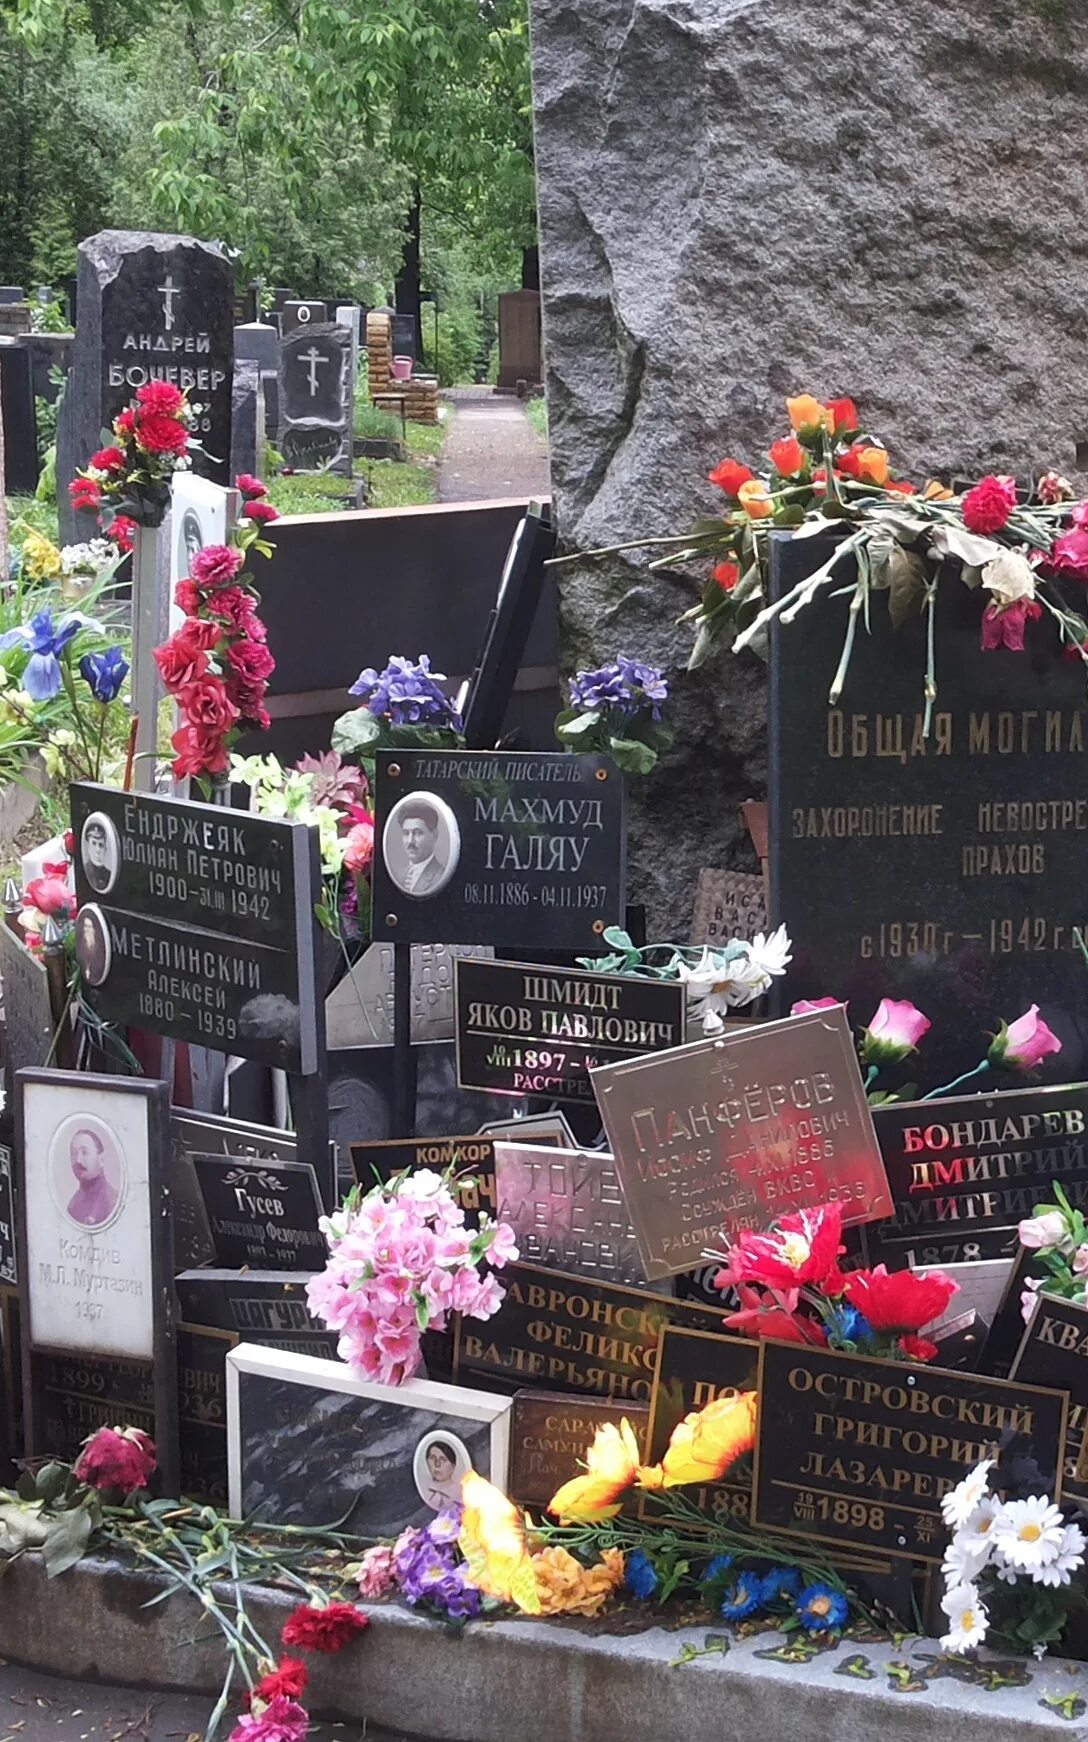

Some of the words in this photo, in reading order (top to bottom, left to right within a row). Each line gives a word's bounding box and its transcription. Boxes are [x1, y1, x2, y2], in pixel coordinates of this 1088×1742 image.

[122, 332, 211, 354] АНДРЕЙ
[108, 363, 226, 391] БОЧЕВЕР
[826, 710, 953, 764] ОБЩАЯ
[415, 757, 499, 780] ТАТАРСКИЙ
[504, 762, 583, 783] ПИСАТЕЛЬ
[123, 803, 247, 857] ЕНДРЖЕЯК
[473, 796, 604, 830] МАХМУД
[792, 804, 943, 838] ЗАХОРОНЕНИЕ
[122, 835, 179, 872] ЮЛИАН
[187, 850, 281, 895] ПЕТРОВИЧ
[483, 833, 591, 873] ГАЛЯУ
[962, 845, 1046, 877] ПРАХОВ
[149, 871, 188, 901] 1900
[231, 891, 271, 922] 1942
[464, 881, 530, 906] 08.11.1886
[541, 885, 607, 909] 04.11.1937
[111, 924, 262, 990] МЕТЛИНСКИЙ
[147, 968, 226, 1010] АЛЕКСЕЙ
[523, 975, 622, 1012] ШМИДТ
[138, 992, 174, 1023] 1880
[199, 1009, 237, 1041] 1939
[467, 1002, 533, 1032] ЯКОВ
[541, 1009, 673, 1047] ПАВЛОВИЧ
[513, 1048, 566, 1072] 1897
[631, 1071, 836, 1153] ПАНФЁРОВ
[902, 1109, 1086, 1154] БОНДАРЕВ
[415, 1145, 491, 1164] КОМКОР
[908, 1140, 1088, 1194] ДМИТРИЙ
[233, 1187, 285, 1220] Гусев
[59, 1239, 121, 1264] Комдив
[788, 1367, 1036, 1436] ОСТРОВСКИЙ
[812, 1411, 1001, 1470] ГРИГОРИЙ
[815, 1496, 885, 1532] 1898
